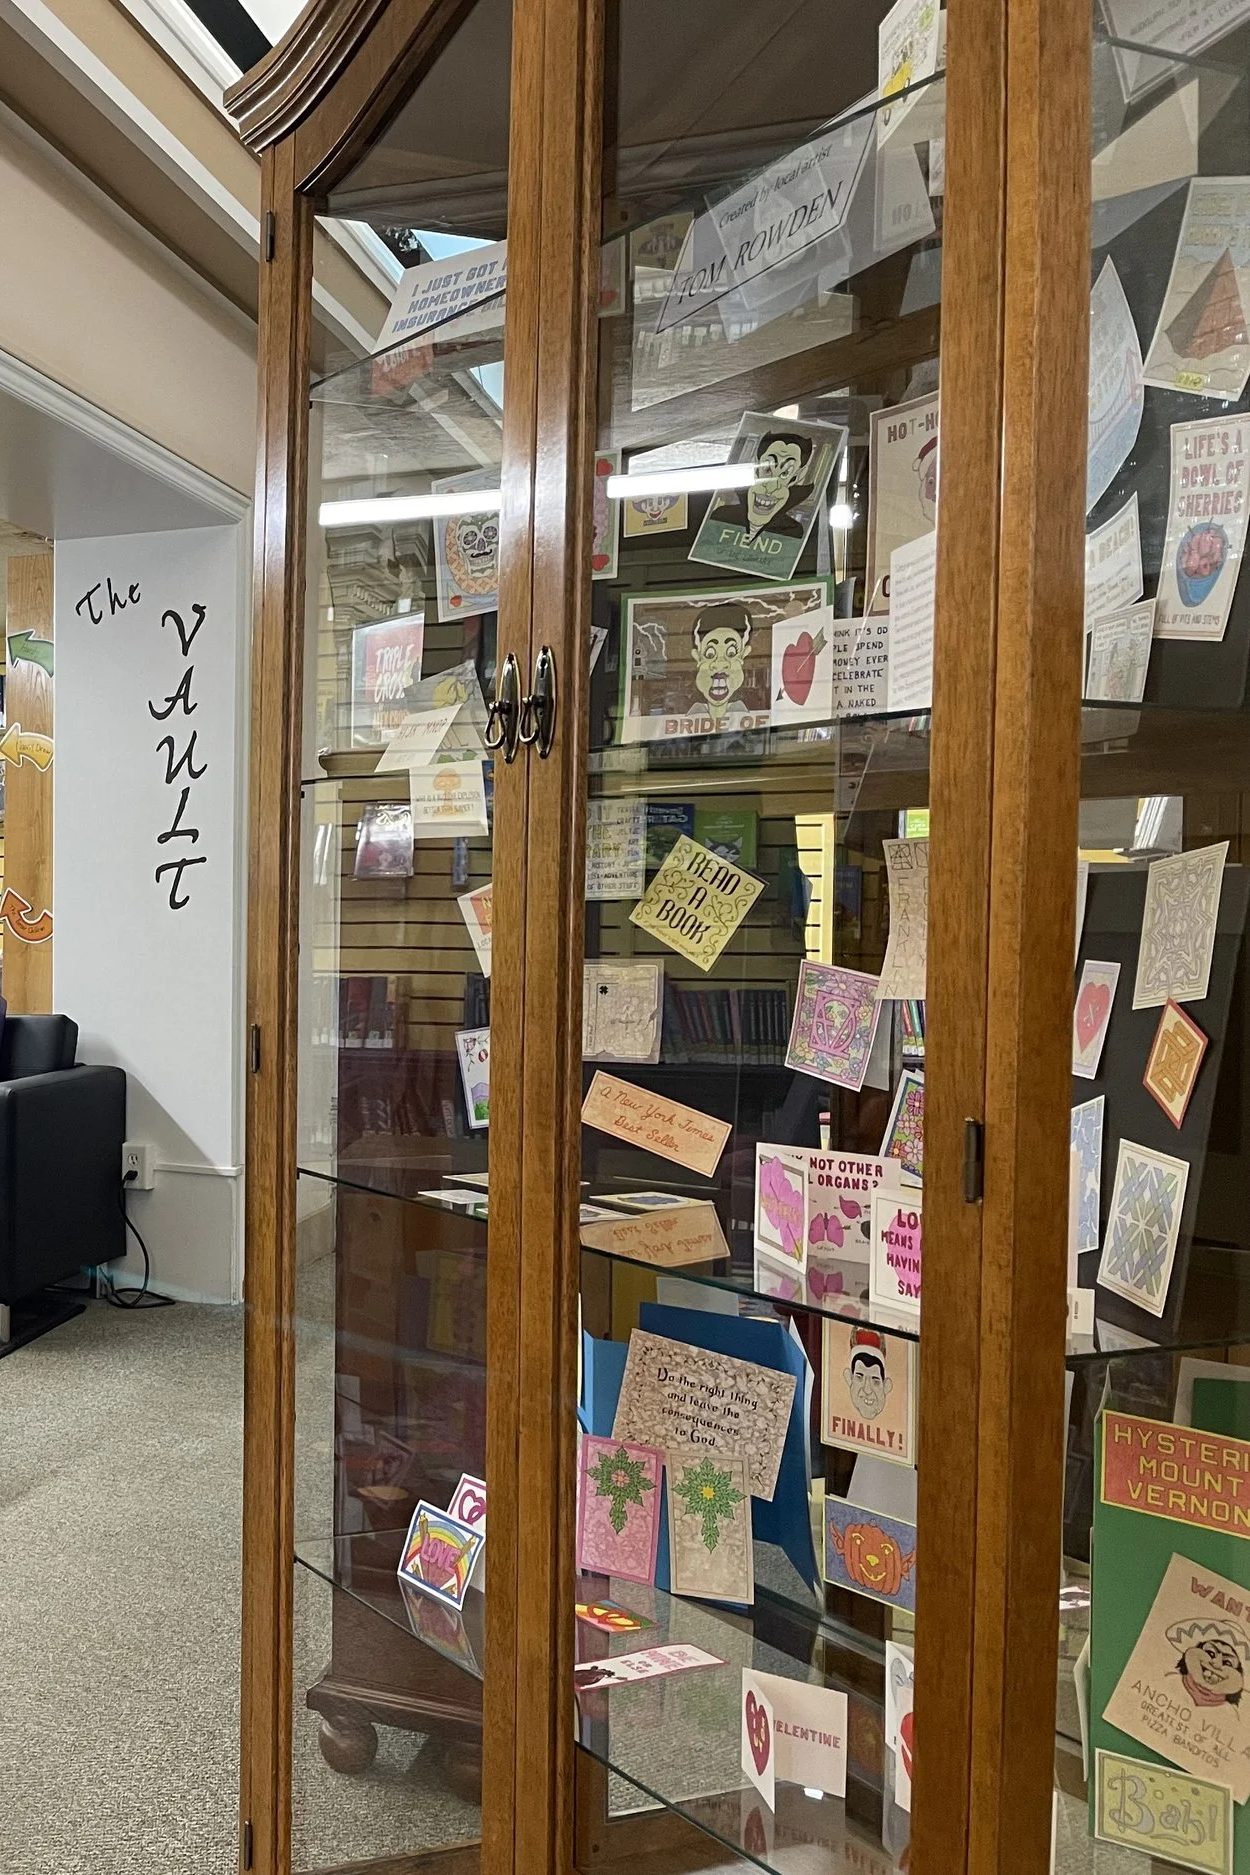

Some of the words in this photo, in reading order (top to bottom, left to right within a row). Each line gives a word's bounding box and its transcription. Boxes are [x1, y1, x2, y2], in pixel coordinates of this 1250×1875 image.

[719, 191, 758, 229] Created
[760, 186, 771, 203] by
[773, 161, 799, 192] local
[800, 144, 832, 174] artist
[677, 254, 727, 304] TOM
[734, 179, 844, 270] ROWDEN
[412, 284, 419, 297] I
[422, 272, 463, 294] JUST
[466, 260, 498, 282] GOT
[1185, 431, 1230, 460] LIFE'S
[1232, 429, 1243, 454] A
[1181, 463, 1220, 489] BOWL
[1225, 460, 1244, 485] OF
[1178, 490, 1243, 518] CHERRIES
[719, 529, 783, 554] FIEND
[75, 577, 141, 625] The
[375, 644, 415, 673] TRIPLE
[832, 668, 884, 681] CELEBRATE
[848, 698, 877, 708] NAKED
[858, 684, 875, 693] THE
[664, 716, 730, 735] BRIDE
[740, 714, 770, 731] OF
[148, 603, 208, 910] VAULT
[687, 852, 741, 895] READ
[688, 887, 707, 910] A
[656, 900, 711, 944] BOOK
[600, 1086, 612, 1099] A
[614, 1090, 643, 1110] New
[640, 1104, 677, 1126] York
[677, 1118, 715, 1143] Times
[614, 1115, 643, 1134] Best
[646, 1129, 680, 1152] Seller
[809, 1157, 835, 1171] NOT
[838, 1162, 883, 1178] OTHER
[881, 1230, 913, 1250] MEANS
[658, 1367, 675, 1382] Do
[679, 1376, 696, 1389] the
[699, 1384, 725, 1399] right
[730, 1391, 758, 1410] thing
[668, 1392, 686, 1403] and
[690, 1395, 718, 1413] leave
[722, 1407, 740, 1419] the
[662, 1407, 739, 1436] consequences
[674, 1427, 686, 1437] to
[832, 1416, 903, 1450] FINALLY!
[1114, 1423, 1250, 1473] HYSTERI
[1139, 1455, 1244, 1497] MOUNT
[1127, 1479, 1250, 1528] VERNON
[420, 1532, 462, 1576] LOVE
[1131, 1680, 1192, 1723] ANCHO
[1141, 1700, 1189, 1735] GREATEST
[1193, 1729, 1205, 1744] OF
[1212, 1743, 1230, 1762] ALL
[1142, 1714, 1168, 1738] PIZZA
[1173, 1734, 1220, 1768] BANDITOS
[1108, 1768, 1218, 1846] Bah!
